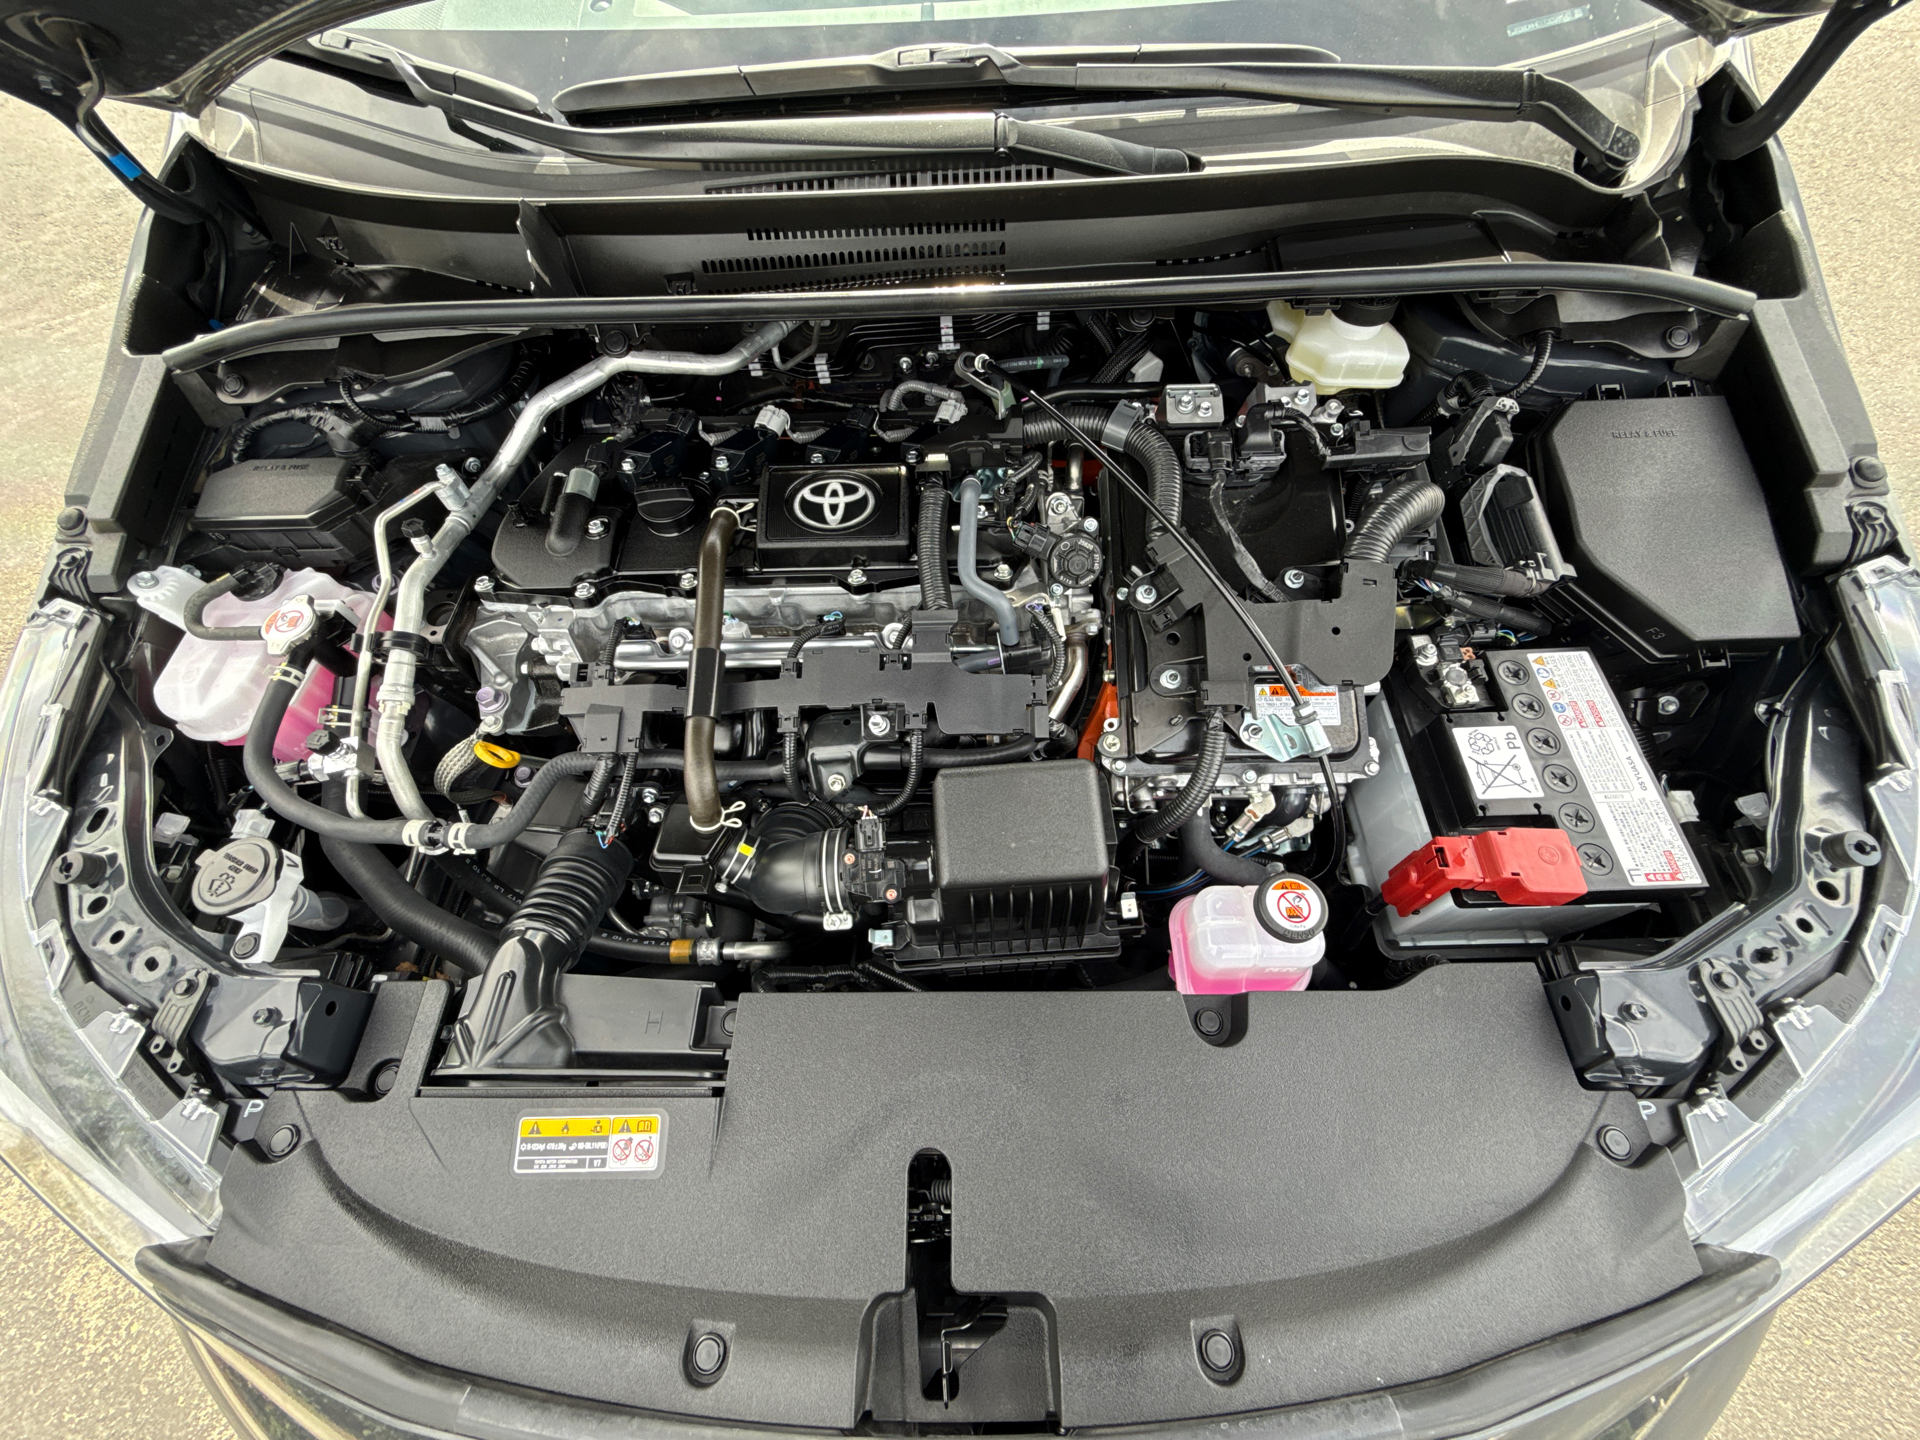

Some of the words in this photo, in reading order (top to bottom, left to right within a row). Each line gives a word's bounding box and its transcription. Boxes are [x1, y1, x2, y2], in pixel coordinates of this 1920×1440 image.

[1612, 430, 1641, 438] RELAY
[1653, 429, 1679, 437] FUSE
[1078, 539, 1094, 550] 25620
[1646, 627, 1665, 639] F3
[1586, 700, 1602, 721] POISON
[1501, 731, 1521, 749] Pb
[1624, 755, 1643, 780] YUASA
[1637, 781, 1648, 790] GS
[223, 852, 245, 867] WASHER
[1663, 851, 1680, 872] DANGER
[1283, 929, 1315, 939] DENSO
[644, 1011, 663, 1034] H
[243, 1101, 264, 1117] P
